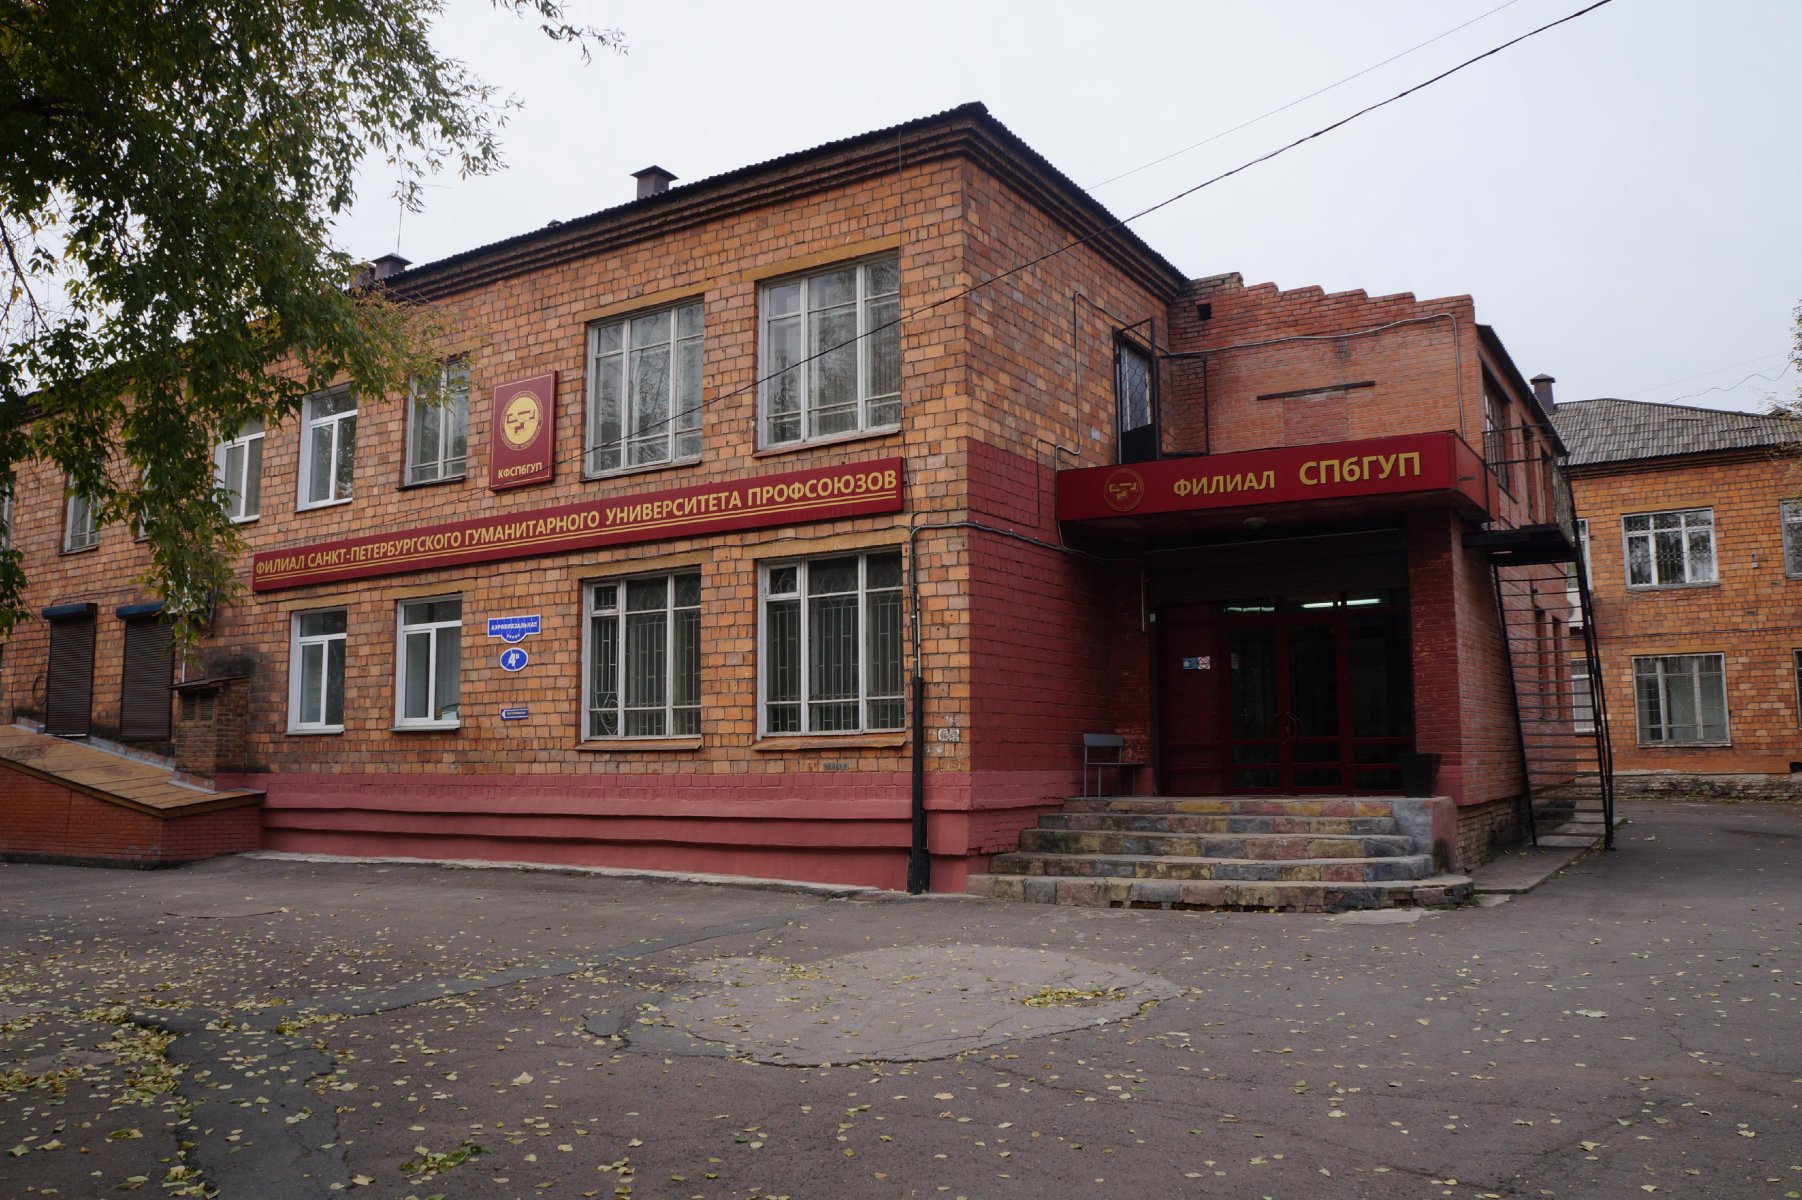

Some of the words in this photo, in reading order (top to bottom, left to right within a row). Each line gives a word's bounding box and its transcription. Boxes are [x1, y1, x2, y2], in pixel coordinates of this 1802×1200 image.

[498, 462, 542, 479] КФСПбГУП
[1173, 470, 1276, 497] ФИЛИАЛ
[1299, 452, 1421, 486] СПбГУП
[256, 555, 305, 575] ФИЛИАЛ
[308, 531, 462, 567] САНКТ-ПЕТЕРБУРГСКОГО
[465, 511, 600, 545] ГУМАНИТАРНОГО
[605, 491, 742, 525] УНИВЕРСИТЕТА
[747, 470, 897, 506] ПРОФСОЮЗОВ
